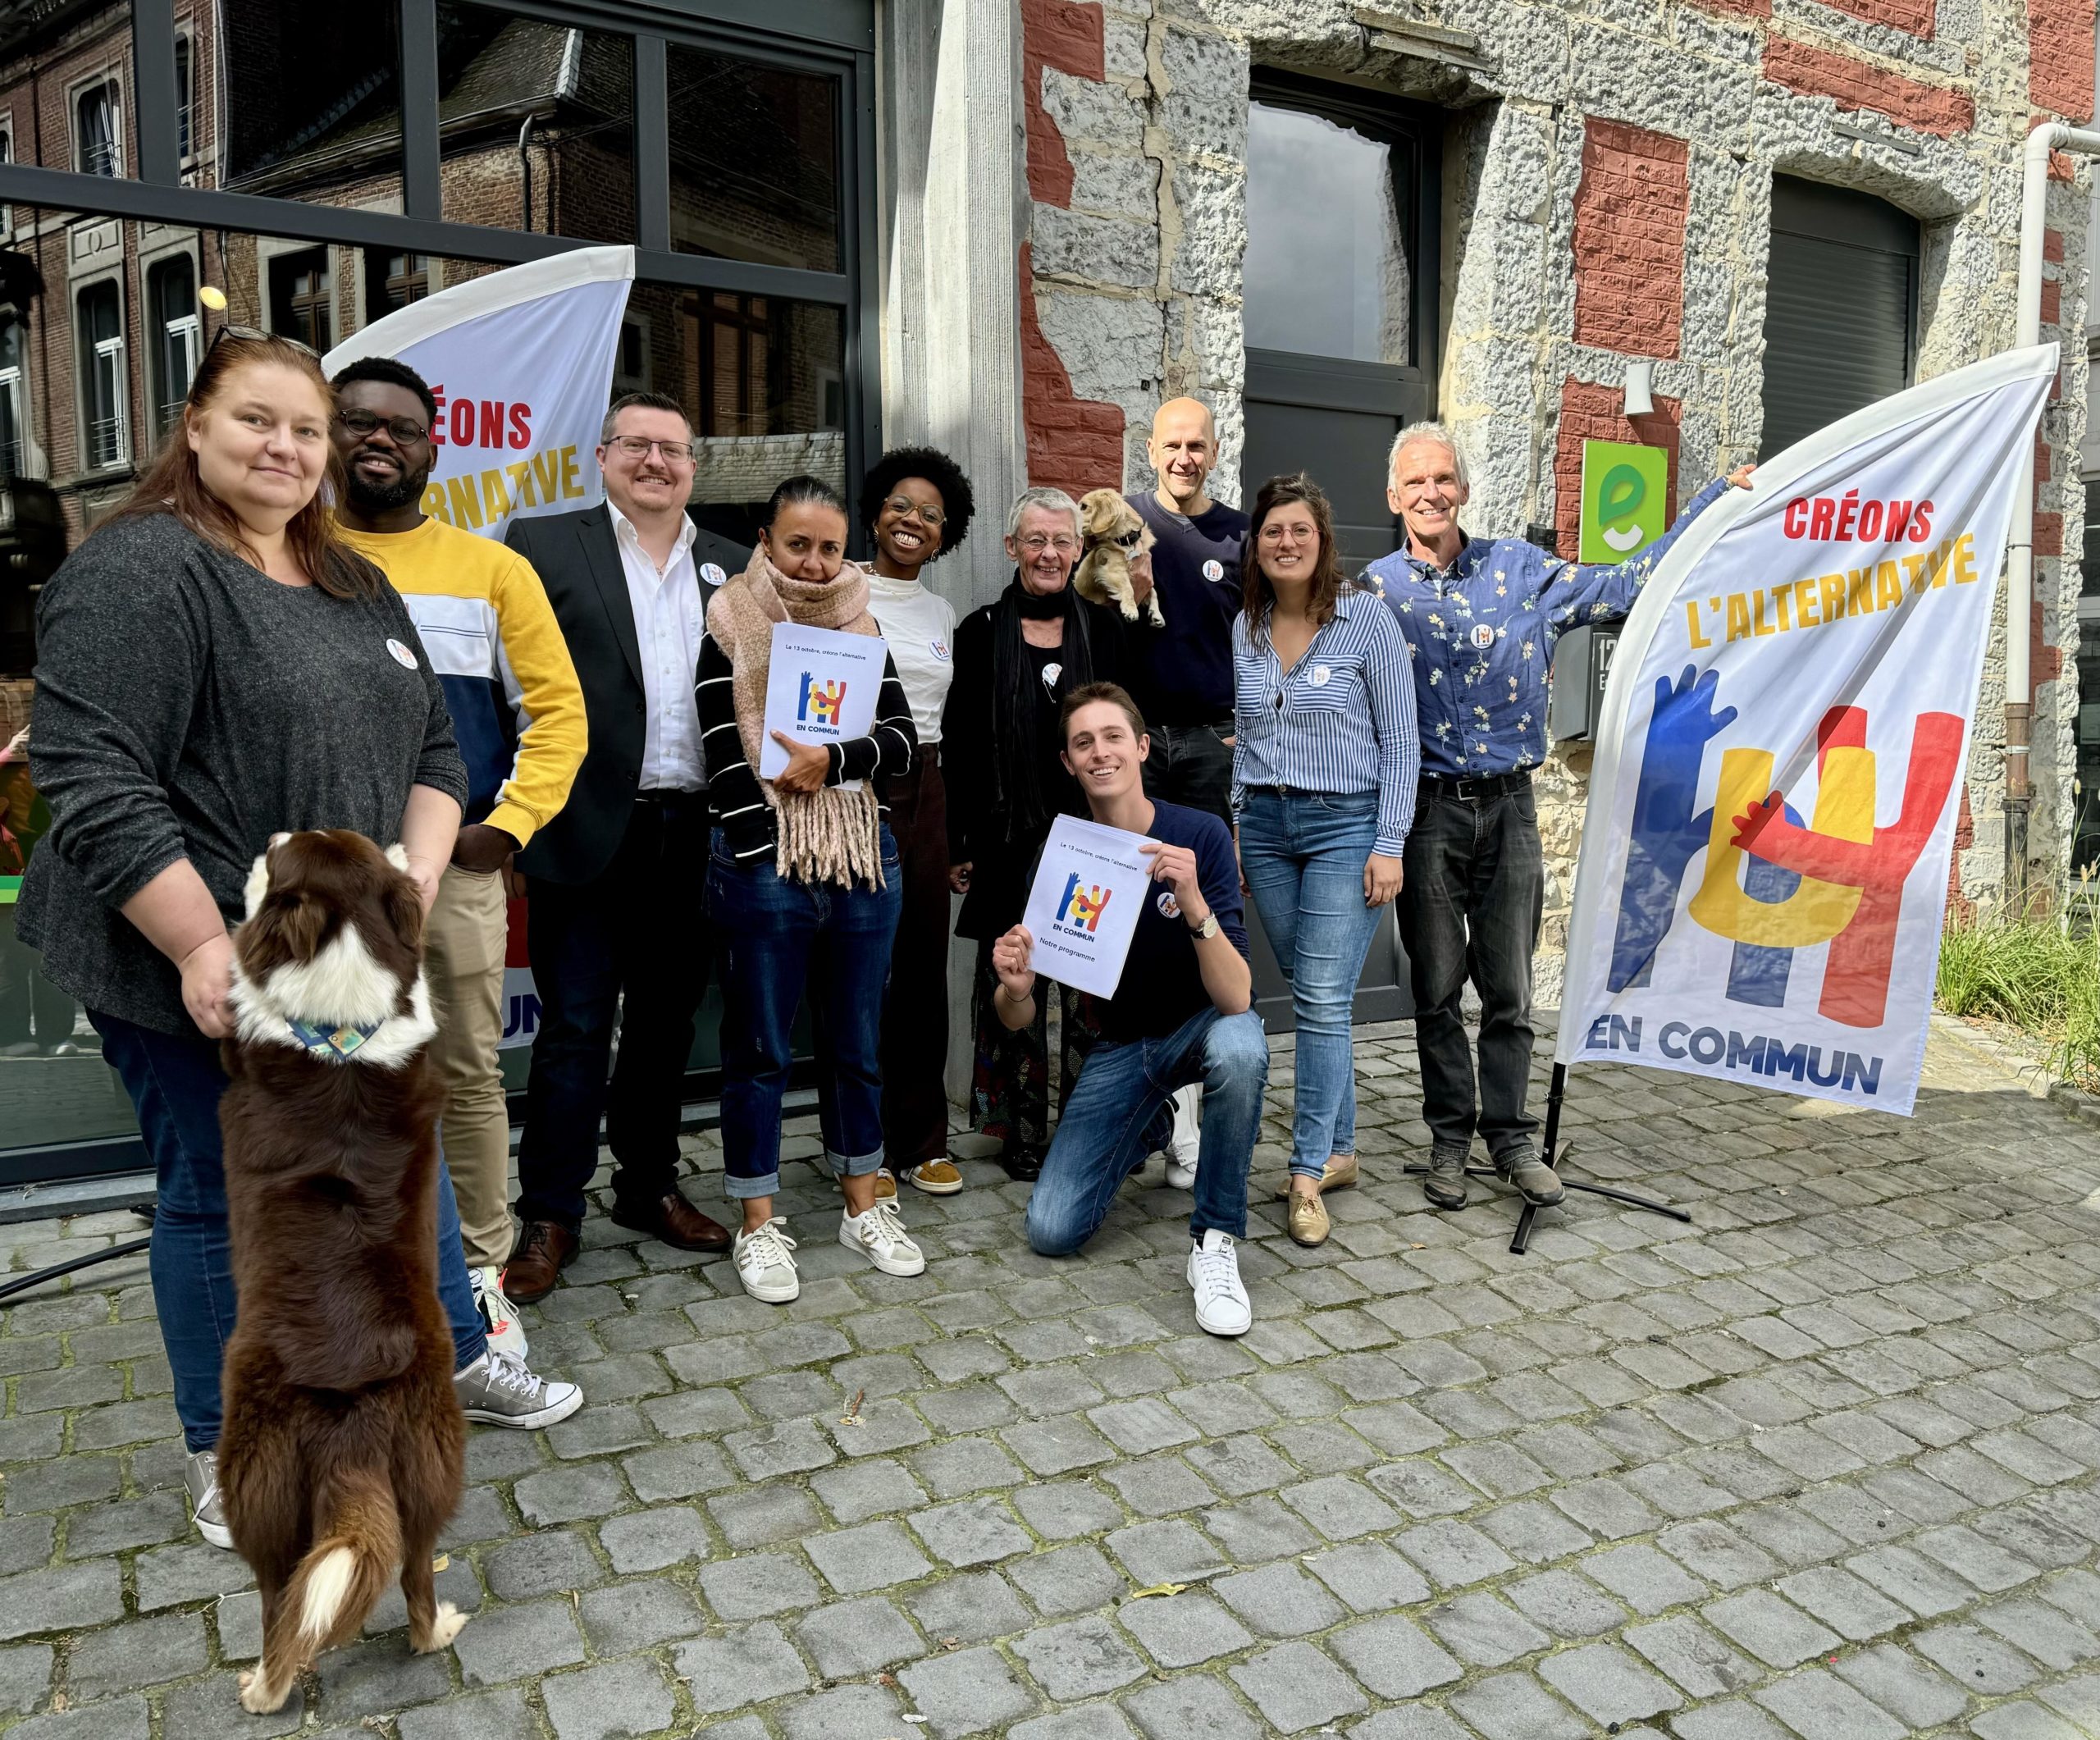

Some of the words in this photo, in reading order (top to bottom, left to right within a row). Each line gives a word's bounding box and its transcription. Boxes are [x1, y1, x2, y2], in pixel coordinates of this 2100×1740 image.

[430, 384, 532, 450] ÉONS
[1783, 488, 1934, 542] CRÉONS
[808, 726, 840, 736] COMMUN
[1039, 937, 1057, 949] Notre
[1057, 945, 1095, 962] programme
[1052, 923, 1062, 931] EN
[1063, 927, 1095, 943] COMMUN
[1586, 1014, 1643, 1053] EN
[1658, 1021, 1883, 1095] COMMUN
